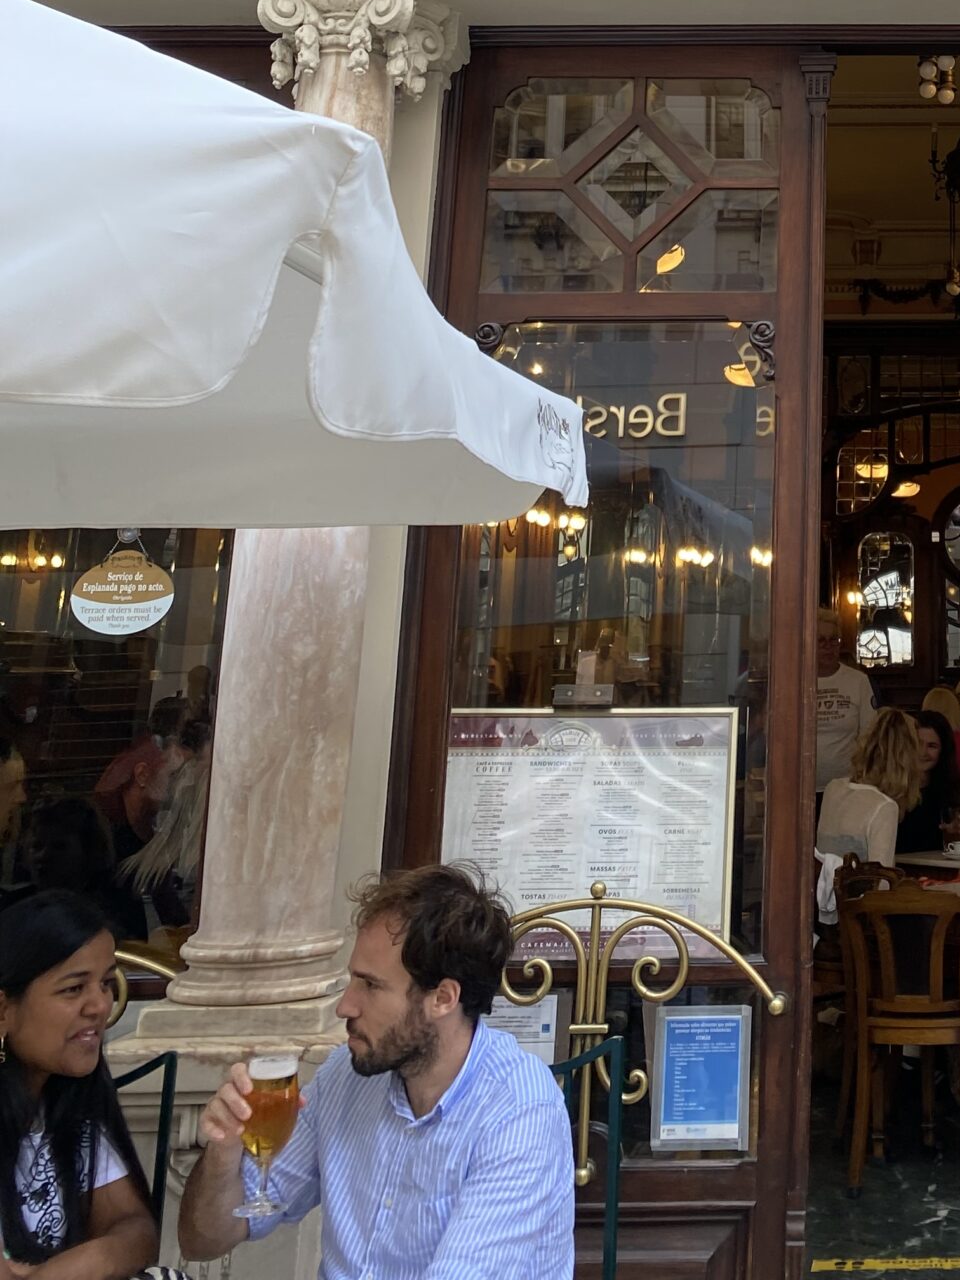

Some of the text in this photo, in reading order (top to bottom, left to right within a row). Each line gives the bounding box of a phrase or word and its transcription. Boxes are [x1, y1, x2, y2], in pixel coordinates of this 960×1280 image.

[107, 571, 144, 583] Serviço de
[83, 582, 165, 594] Esplanada pago no acto.
[81, 605, 162, 614] Terrace orders must be
[88, 614, 104, 623] paid
[105, 614, 125, 622] when
